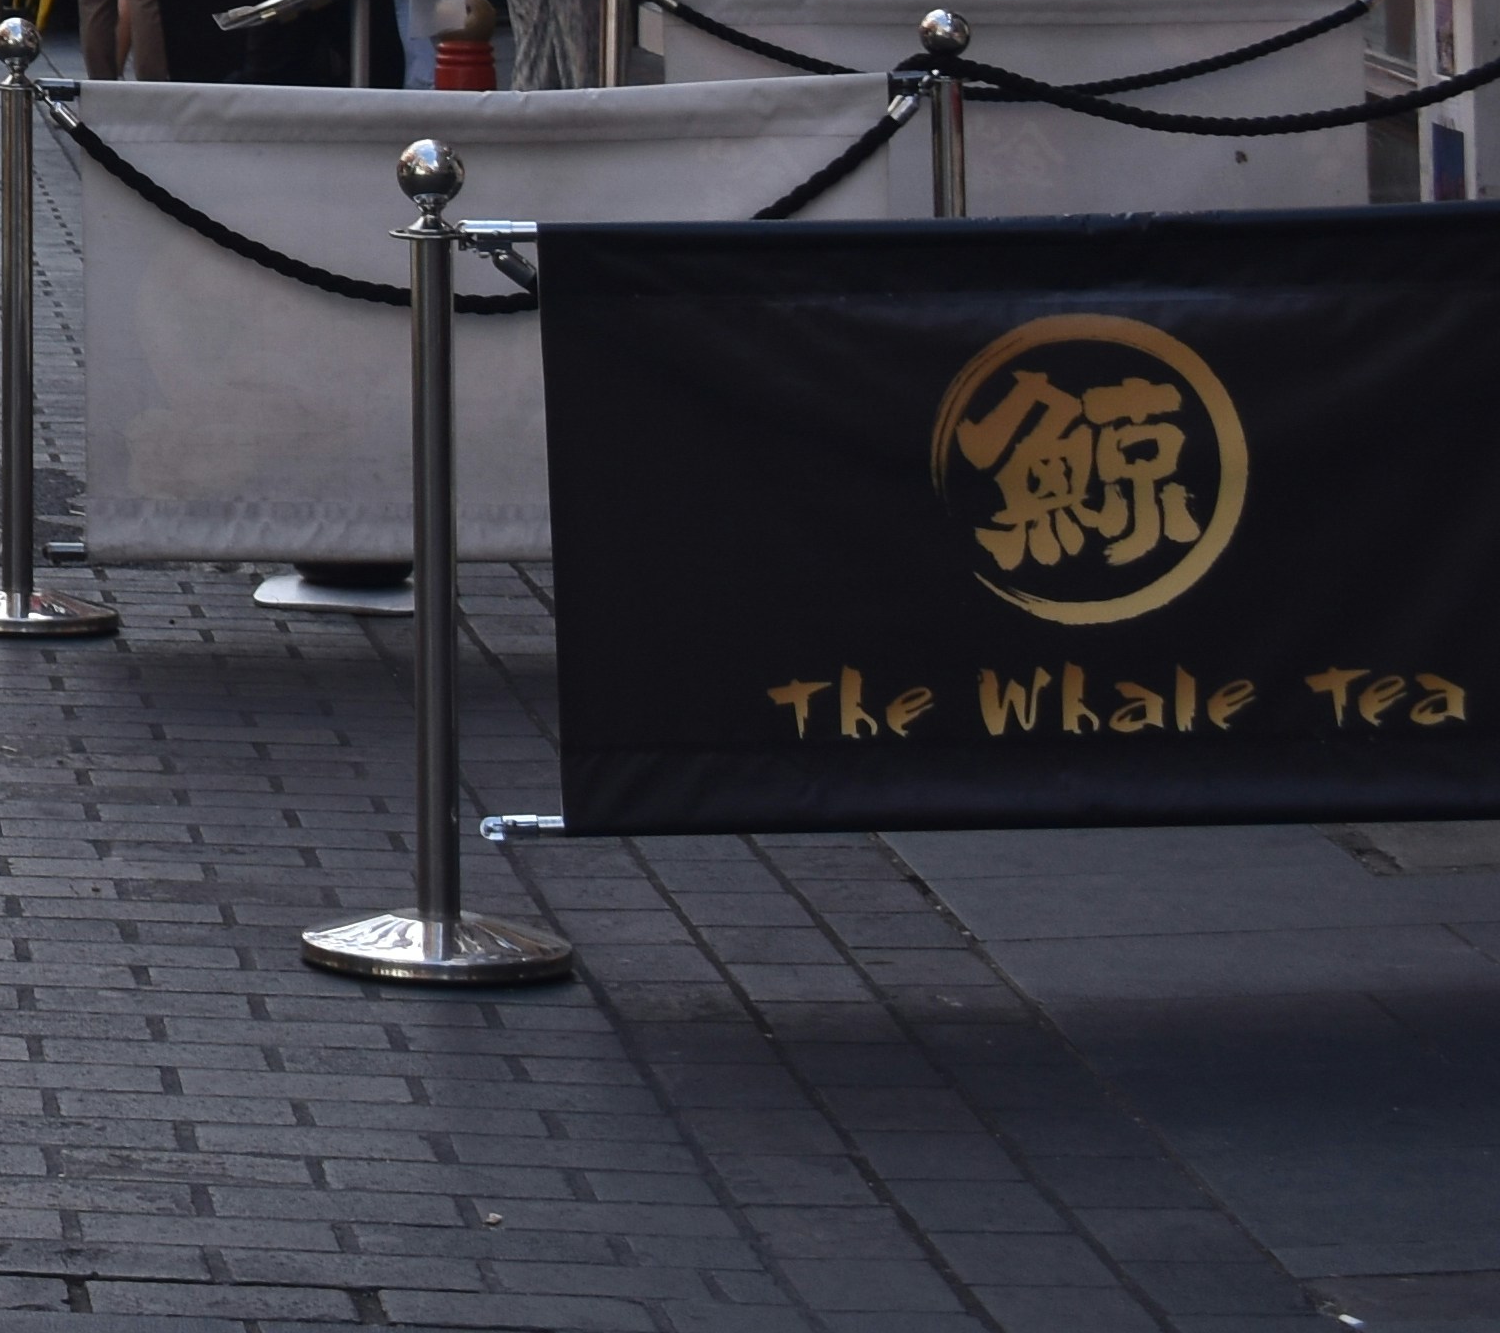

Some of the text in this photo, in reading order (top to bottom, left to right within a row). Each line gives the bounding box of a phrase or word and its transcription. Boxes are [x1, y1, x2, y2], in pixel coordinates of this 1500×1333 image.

[767, 662, 1467, 740] The Whale Tea
